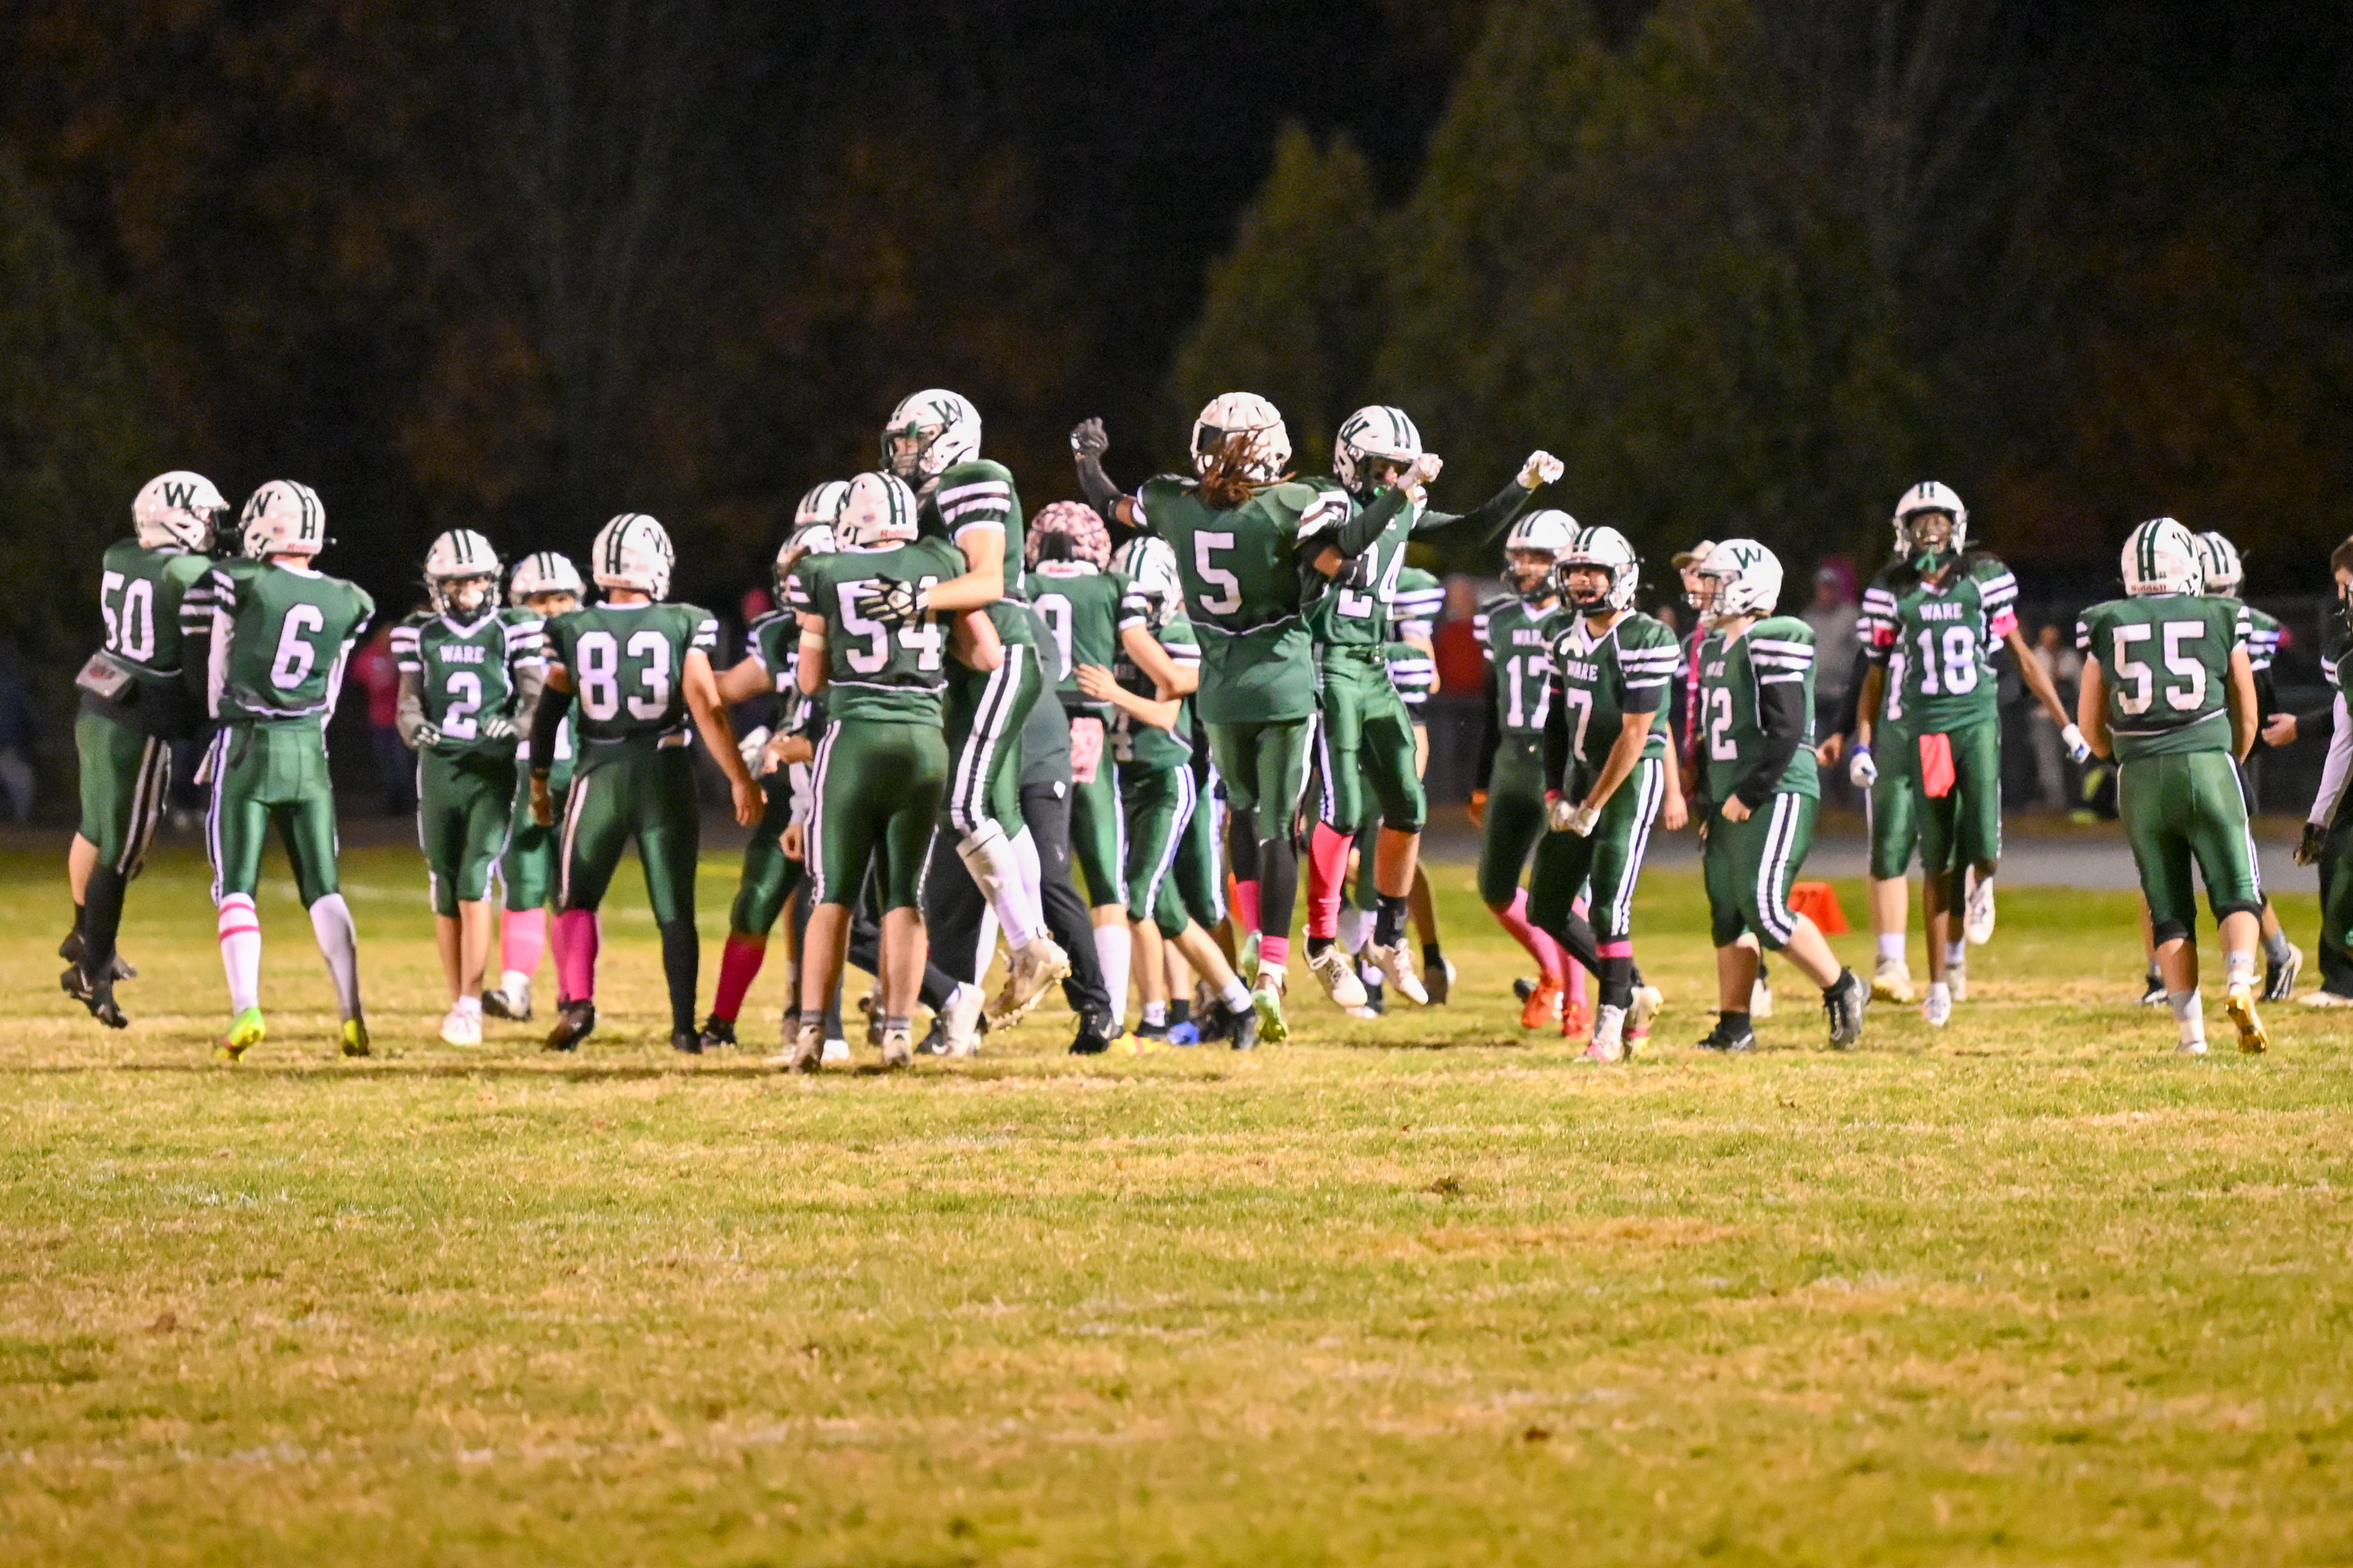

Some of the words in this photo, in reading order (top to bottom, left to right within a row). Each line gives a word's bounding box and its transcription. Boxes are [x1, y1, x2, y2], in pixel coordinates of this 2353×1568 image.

[163, 481, 198, 509] W
[1194, 530, 1242, 615] 5
[1729, 546, 1761, 569] W
[101, 570, 155, 662] 50
[270, 603, 324, 689] 6
[836, 575, 941, 674] 54
[1919, 602, 1963, 621] WARE
[439, 645, 485, 664] WARE
[576, 631, 670, 721] 83
[1506, 654, 1553, 729] 17
[1916, 625, 1977, 695] 18
[2112, 621, 2207, 715] 55
[442, 671, 481, 739] 2
[1567, 687, 1593, 762] 7
